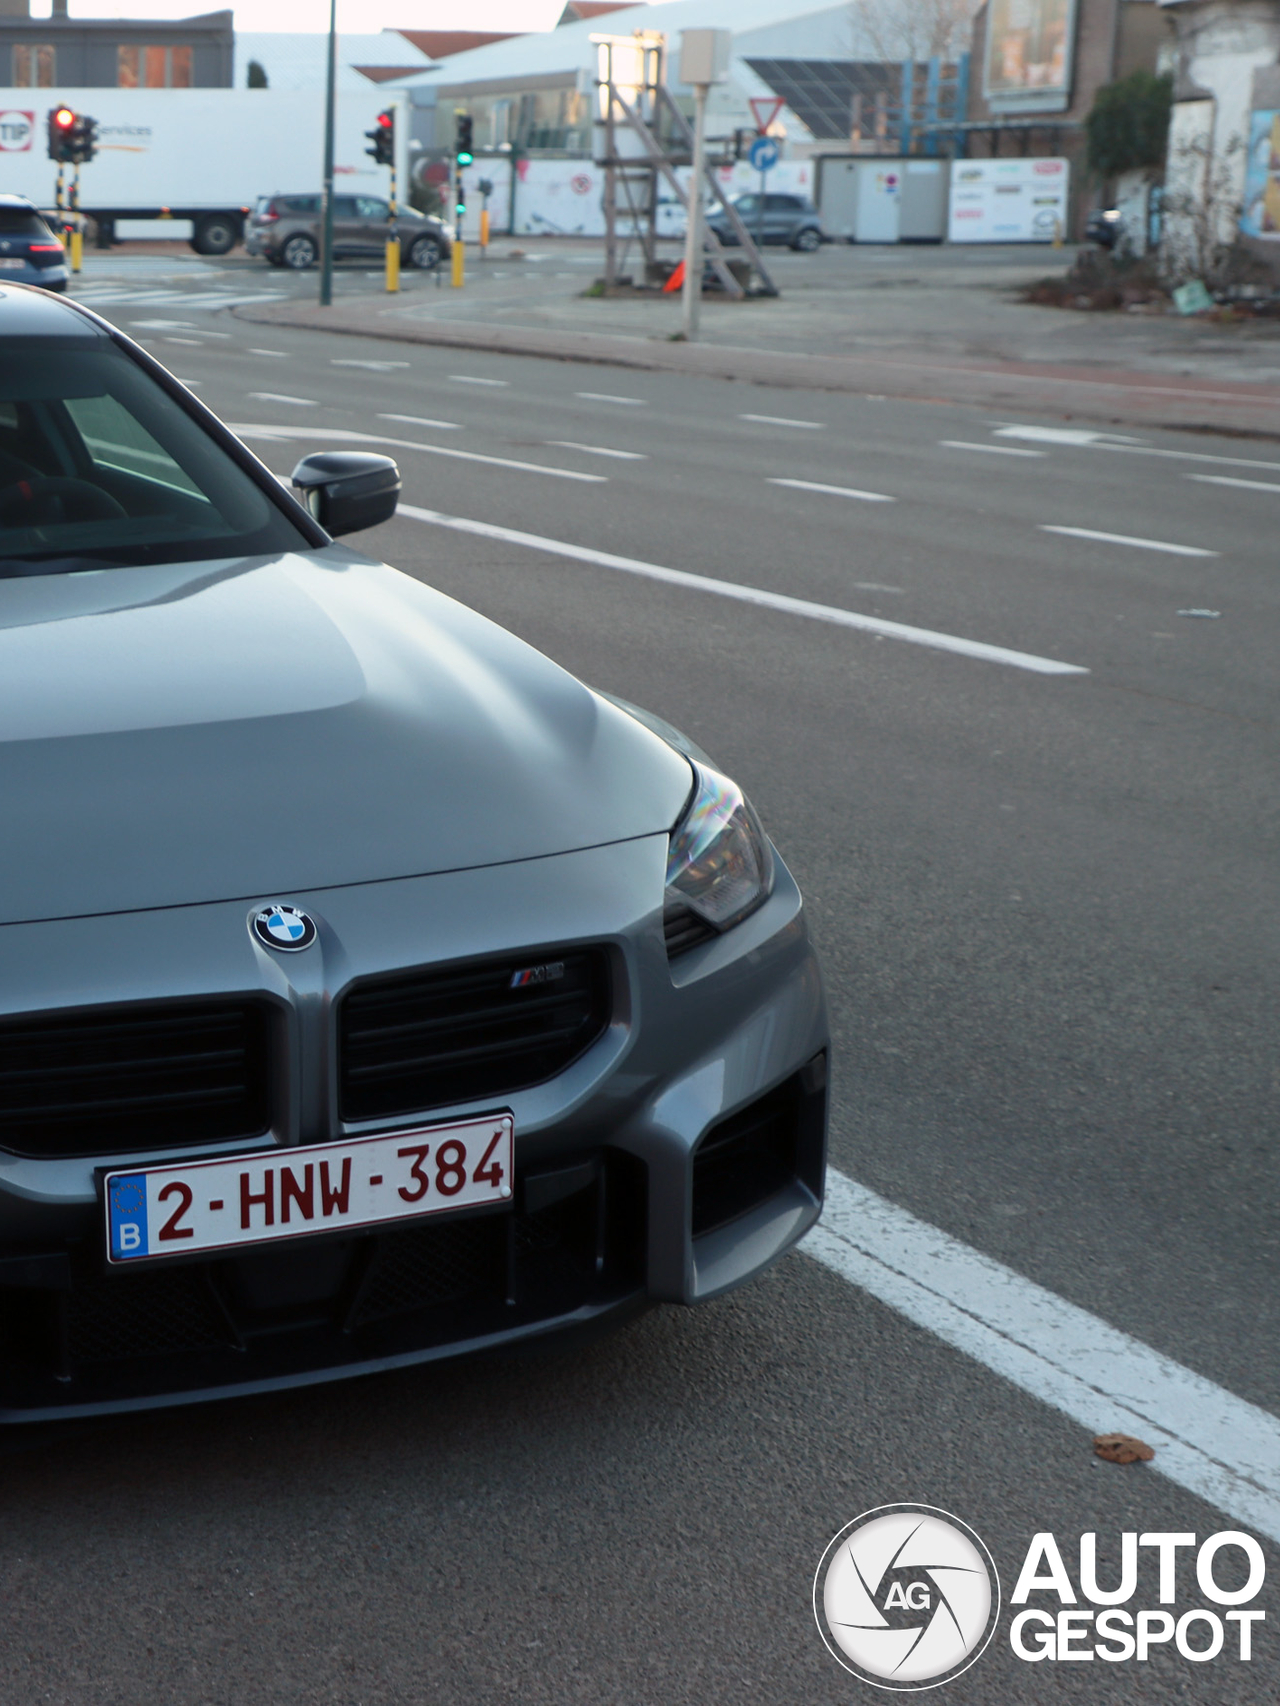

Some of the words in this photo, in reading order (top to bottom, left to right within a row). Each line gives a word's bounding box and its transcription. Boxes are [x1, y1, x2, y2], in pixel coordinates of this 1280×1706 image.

[0, 123, 29, 141] TIP
[257, 905, 305, 922] BMW
[157, 1131, 504, 1242] 2-HNW-384
[119, 1223, 141, 1251] B
